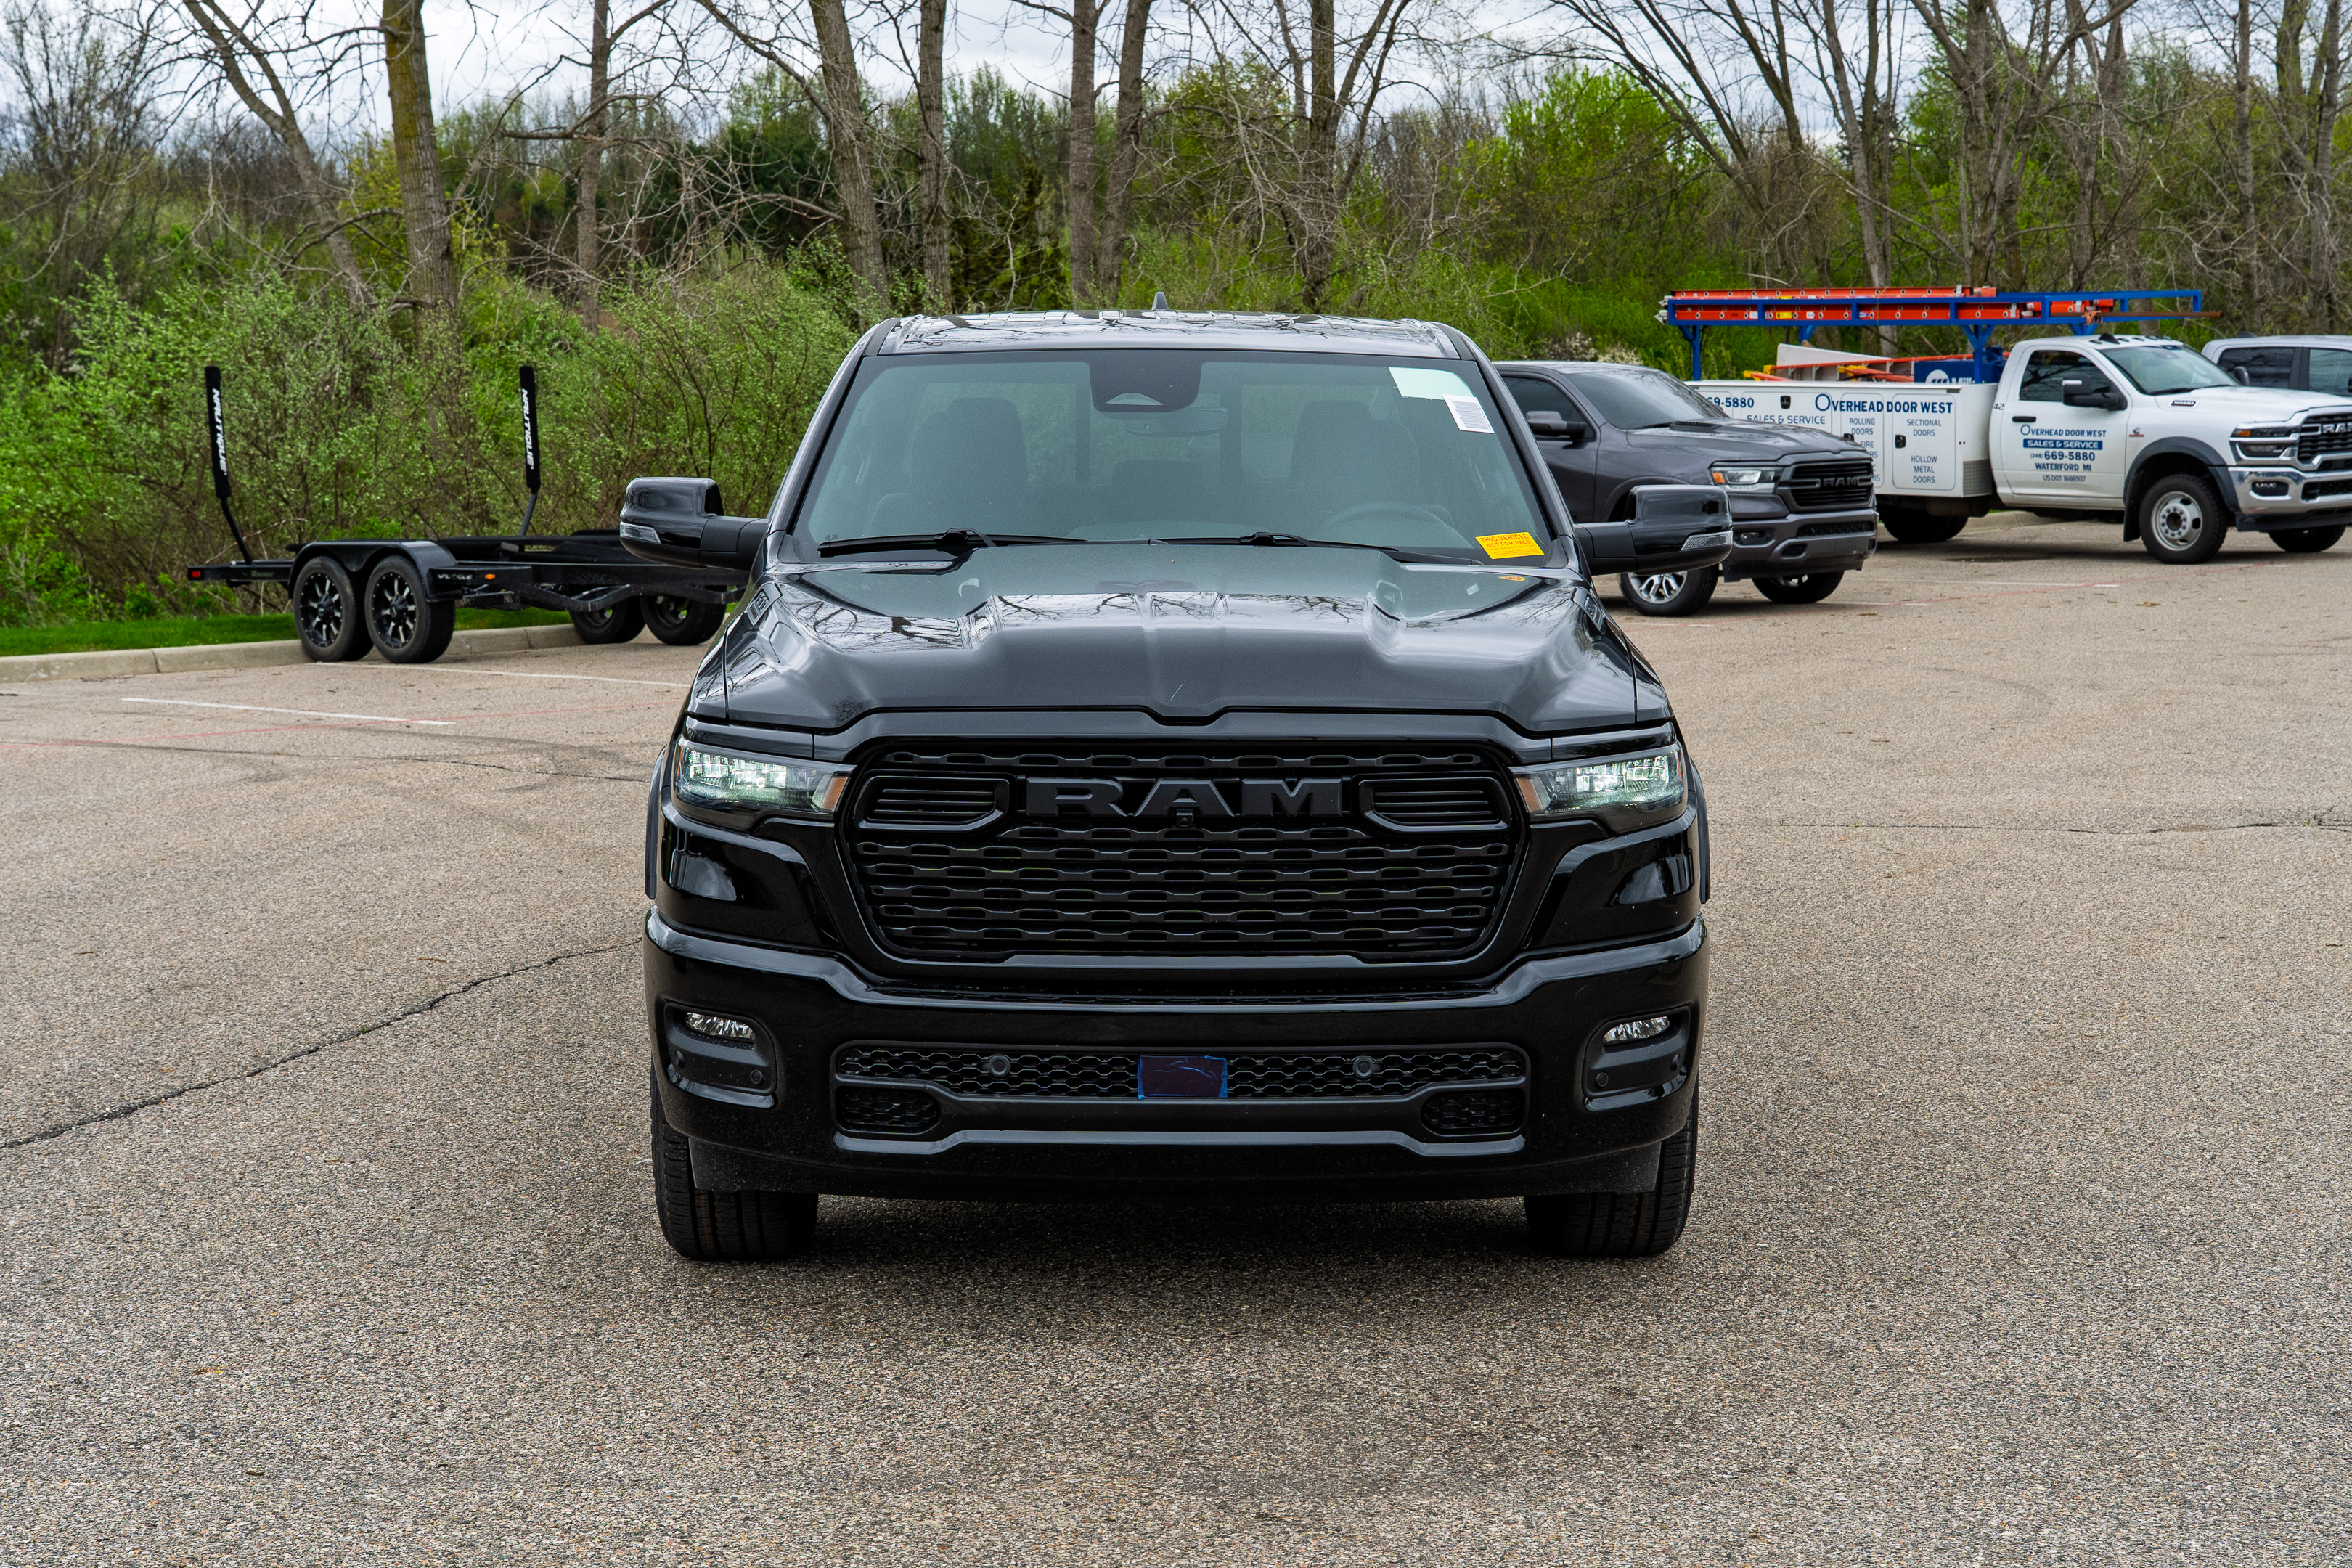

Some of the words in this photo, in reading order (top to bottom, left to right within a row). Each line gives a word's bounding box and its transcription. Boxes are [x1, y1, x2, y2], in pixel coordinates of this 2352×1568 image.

[1886, 401, 1917, 413] DOOR
[1920, 401, 1953, 413] WEST
[1787, 416, 1826, 425] SERVICE
[213, 388, 228, 473] NAUTIQUE
[522, 388, 534, 467] NAUTIQUE
[2044, 450, 2095, 461] 669-5880
[2035, 462, 2080, 471] WATERFORD
[1823, 476, 1858, 487] RAM
[1026, 777, 1343, 817] RAM
